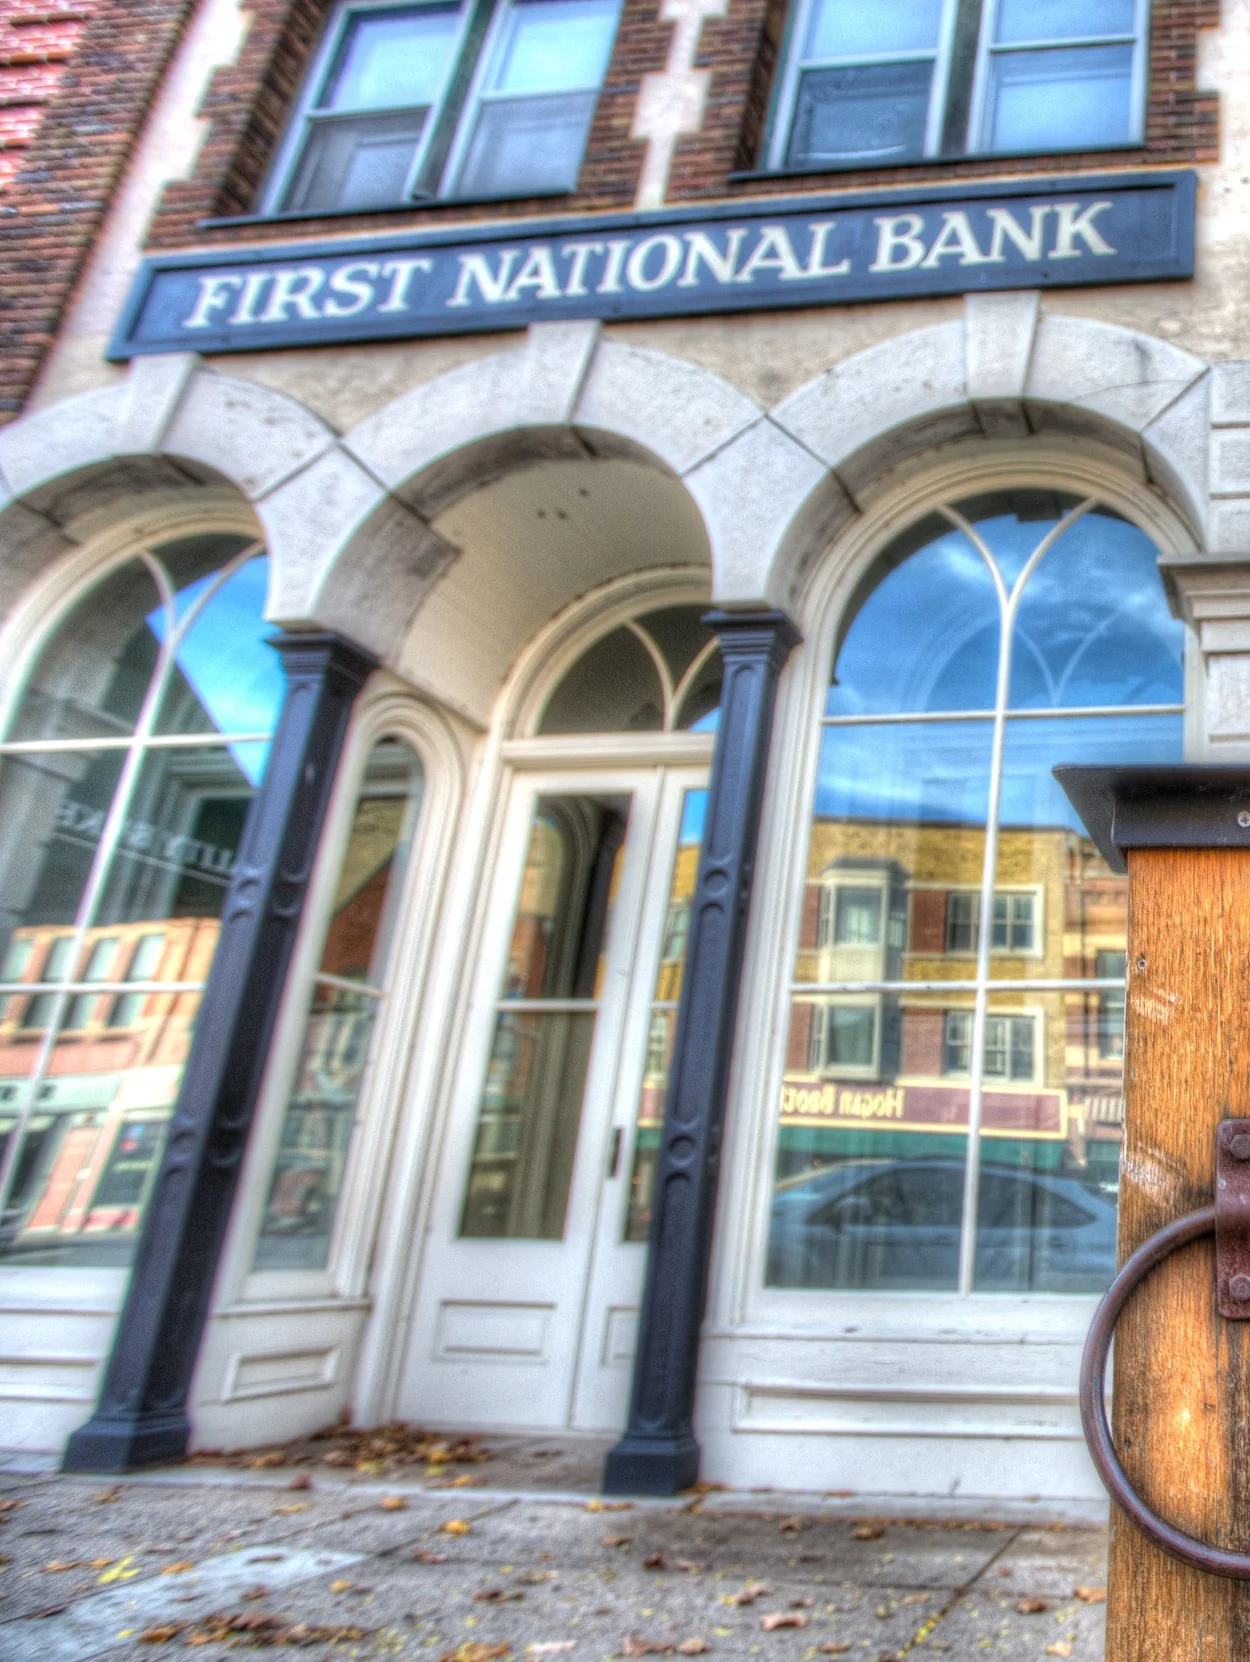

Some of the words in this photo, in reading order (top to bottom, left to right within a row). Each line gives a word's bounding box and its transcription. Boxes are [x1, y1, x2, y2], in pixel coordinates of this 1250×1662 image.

[183, 258, 434, 328] FIRST
[446, 221, 850, 307] NATIONAL
[868, 200, 1117, 274] BANK
